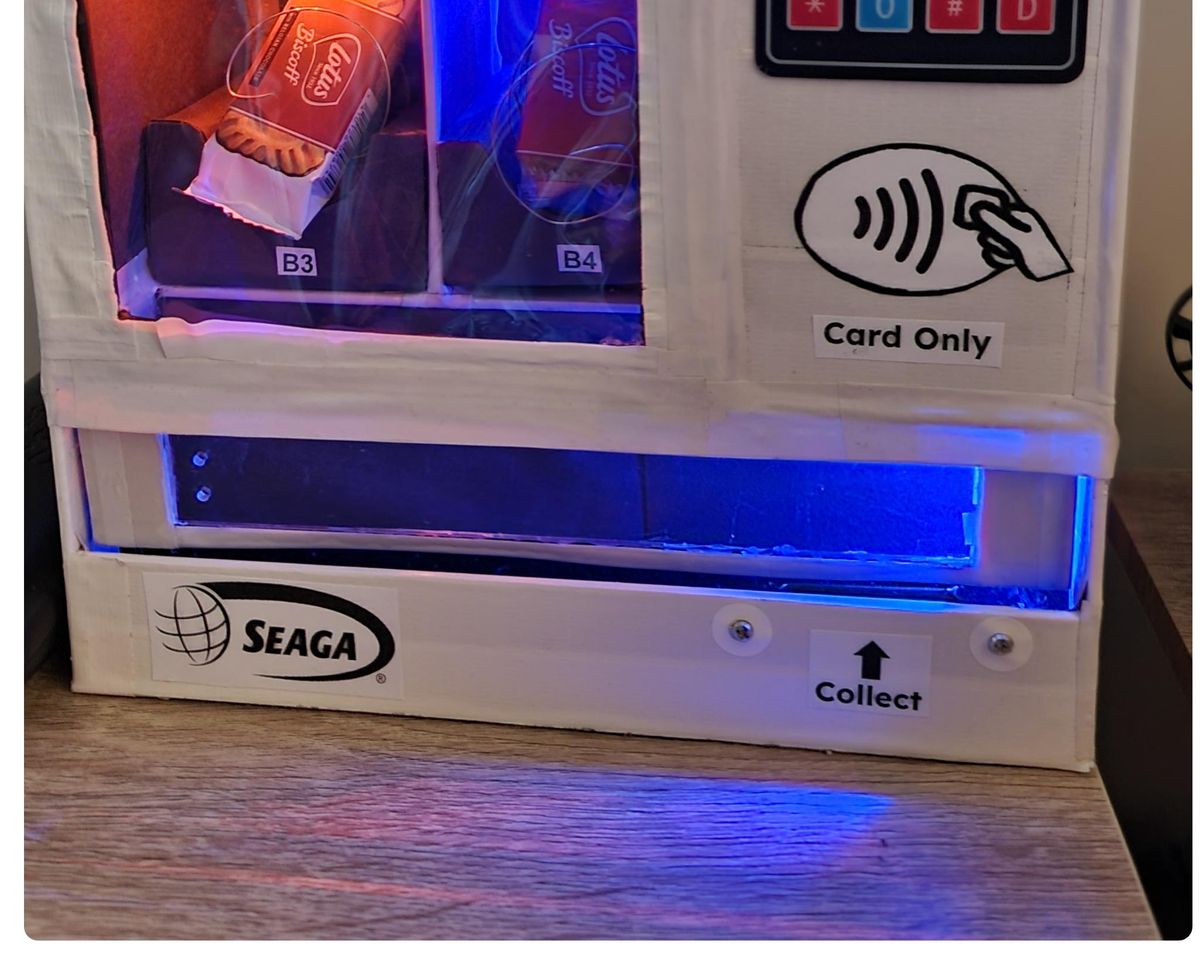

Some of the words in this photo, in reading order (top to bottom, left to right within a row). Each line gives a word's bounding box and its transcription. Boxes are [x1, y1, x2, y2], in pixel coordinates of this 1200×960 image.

[283, 23, 315, 86] Biscoff
[282, 254, 313, 274] B3
[564, 251, 597, 271] B4
[823, 322, 902, 348] Card
[914, 327, 992, 360] Only
[242, 619, 357, 661] SEAGA
[815, 681, 923, 711] Collect
